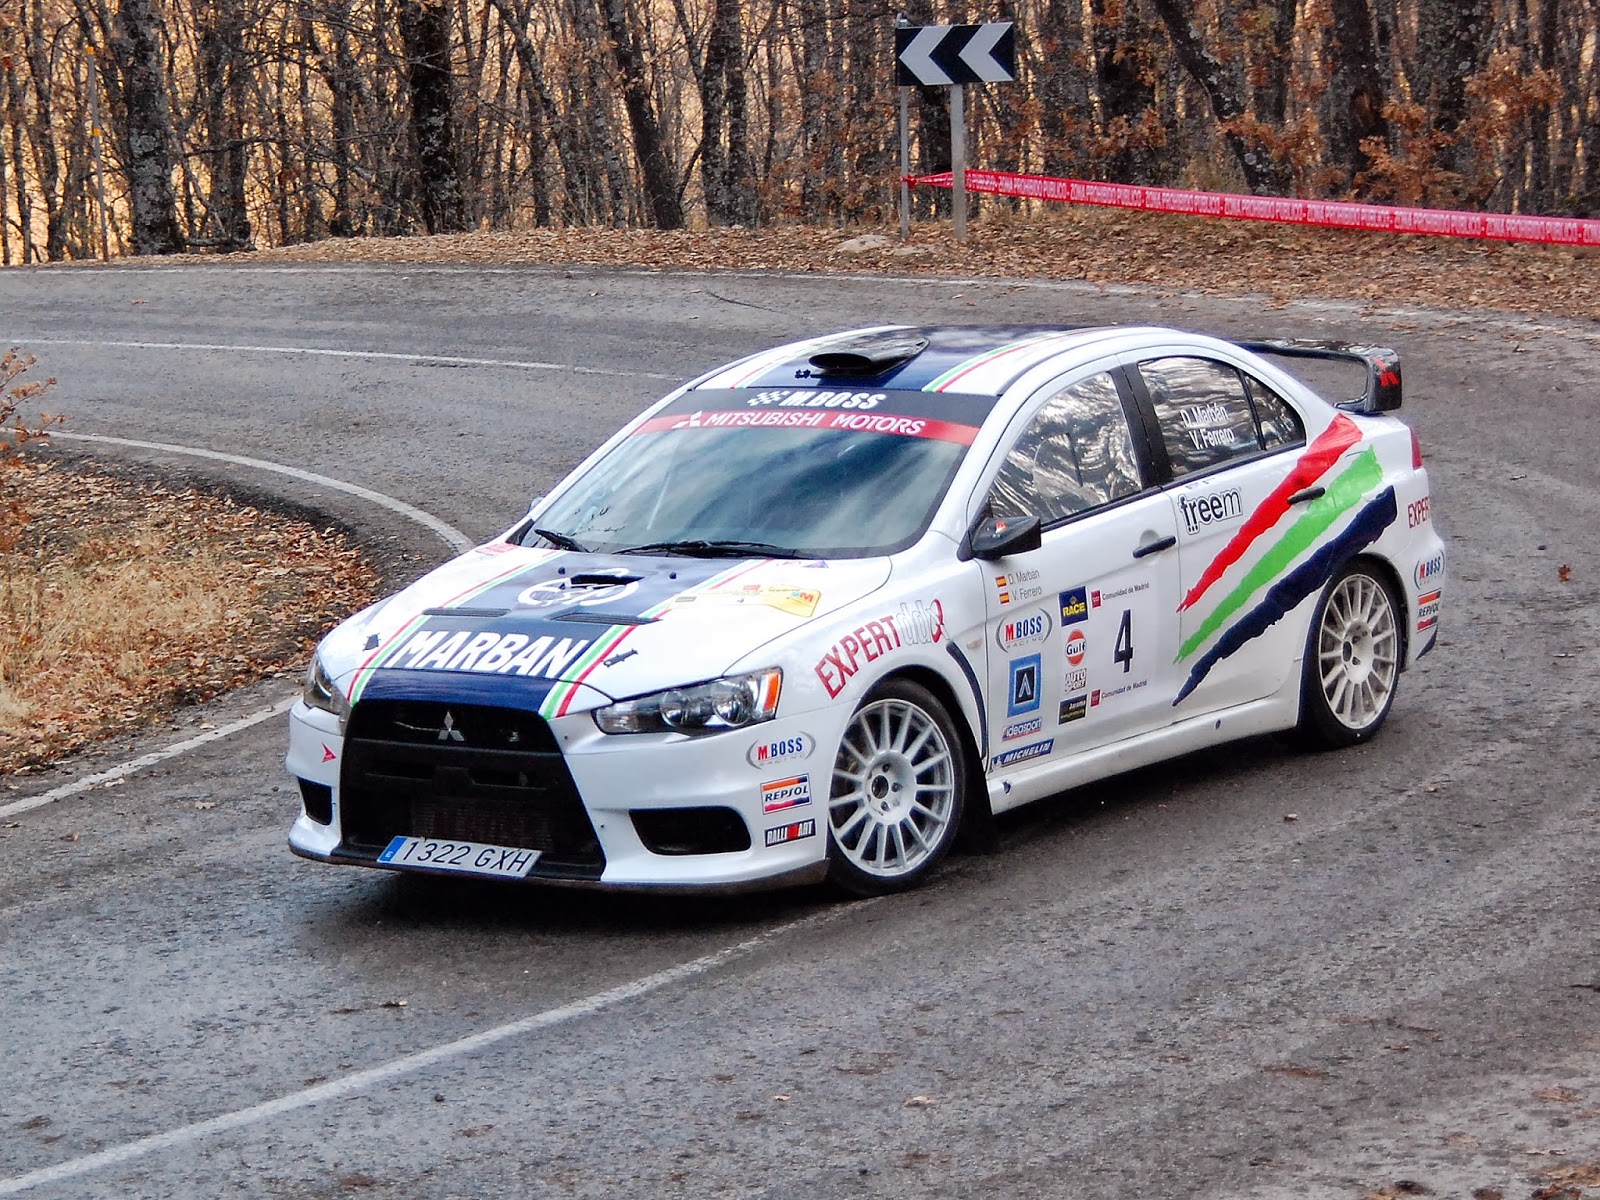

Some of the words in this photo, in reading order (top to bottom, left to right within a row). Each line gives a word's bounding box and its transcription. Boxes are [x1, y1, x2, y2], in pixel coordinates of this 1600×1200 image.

[777, 390, 887, 410] M.BOSS
[704, 411, 826, 428] MITSUBISHI
[833, 412, 926, 435] MOTORS
[1188, 429, 1203, 450] V.
[1200, 428, 1235, 448] Ferrero
[1179, 488, 1243, 534] freem
[1019, 586, 1043, 601] Ferrero
[1134, 581, 1150, 592] Madrid
[1062, 602, 1086, 617] RACE
[1066, 641, 1086, 655] Gulf
[1113, 608, 1134, 674] 4
[383, 630, 590, 680] MARBAN
[814, 614, 901, 700] EXPERT
[1132, 680, 1147, 689] Madrid
[1003, 742, 1052, 764] MICHELIN
[765, 785, 808, 802] REPSOL
[403, 841, 472, 866] 1322
[474, 848, 532, 873] GXH
